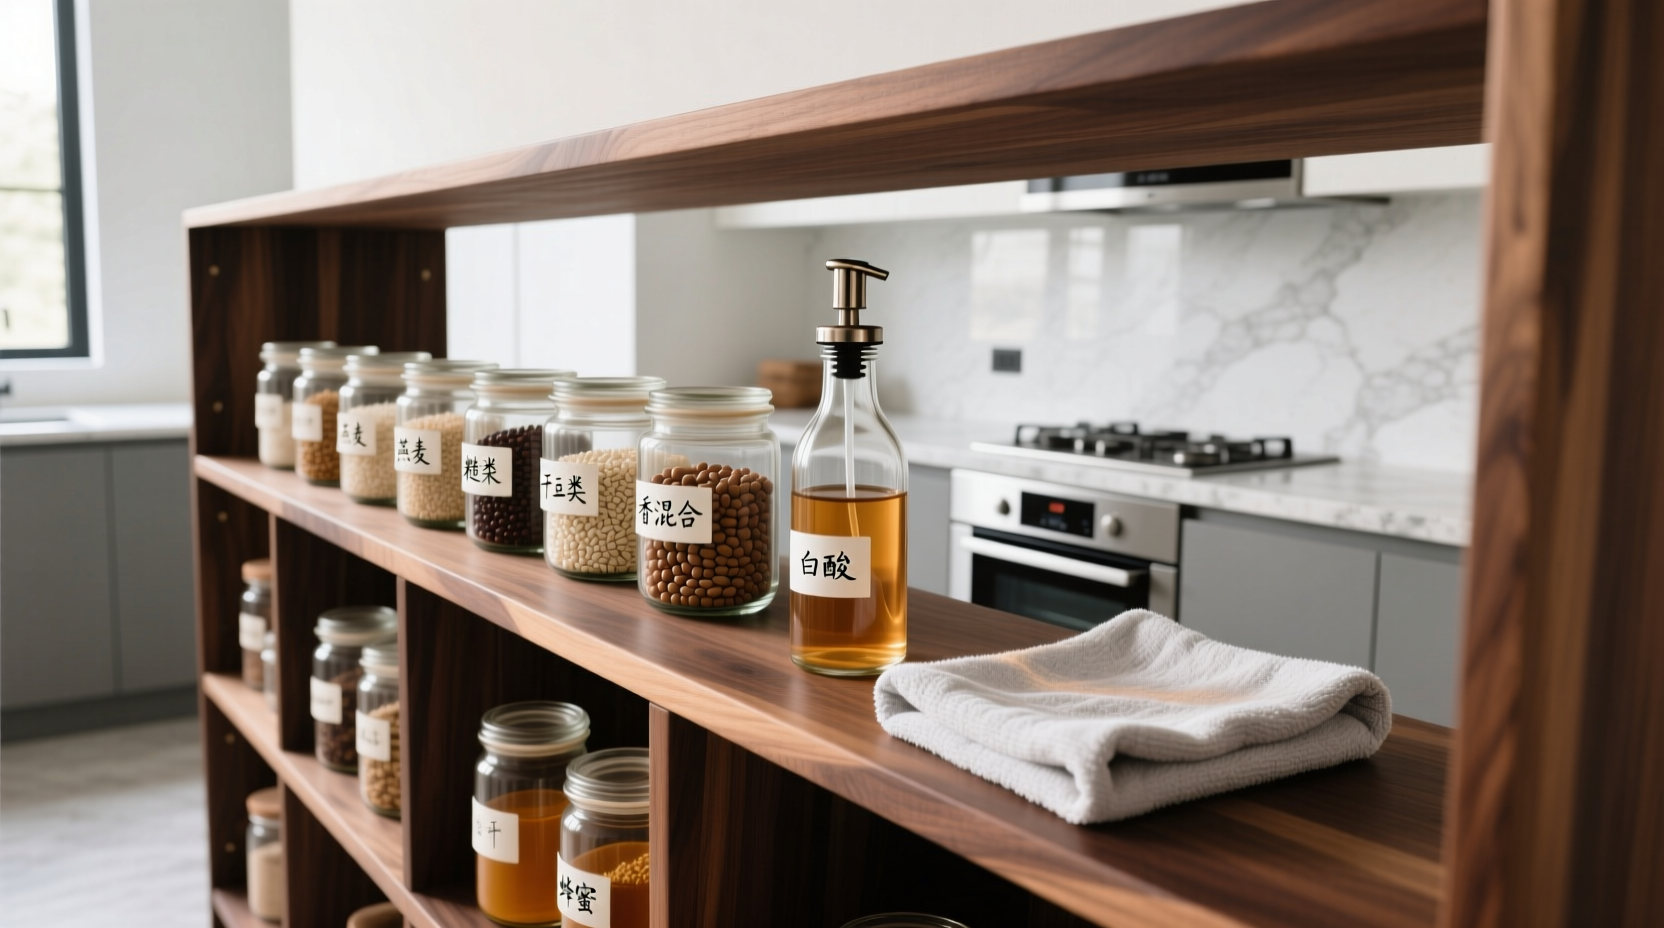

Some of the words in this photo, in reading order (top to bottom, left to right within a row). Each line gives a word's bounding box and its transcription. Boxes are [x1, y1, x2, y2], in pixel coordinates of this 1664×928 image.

[397, 436, 431, 466] 燕麦
[638, 495, 703, 529] 香混合
[801, 550, 857, 581] 白酸
[559, 874, 597, 915] 蜂蜜
